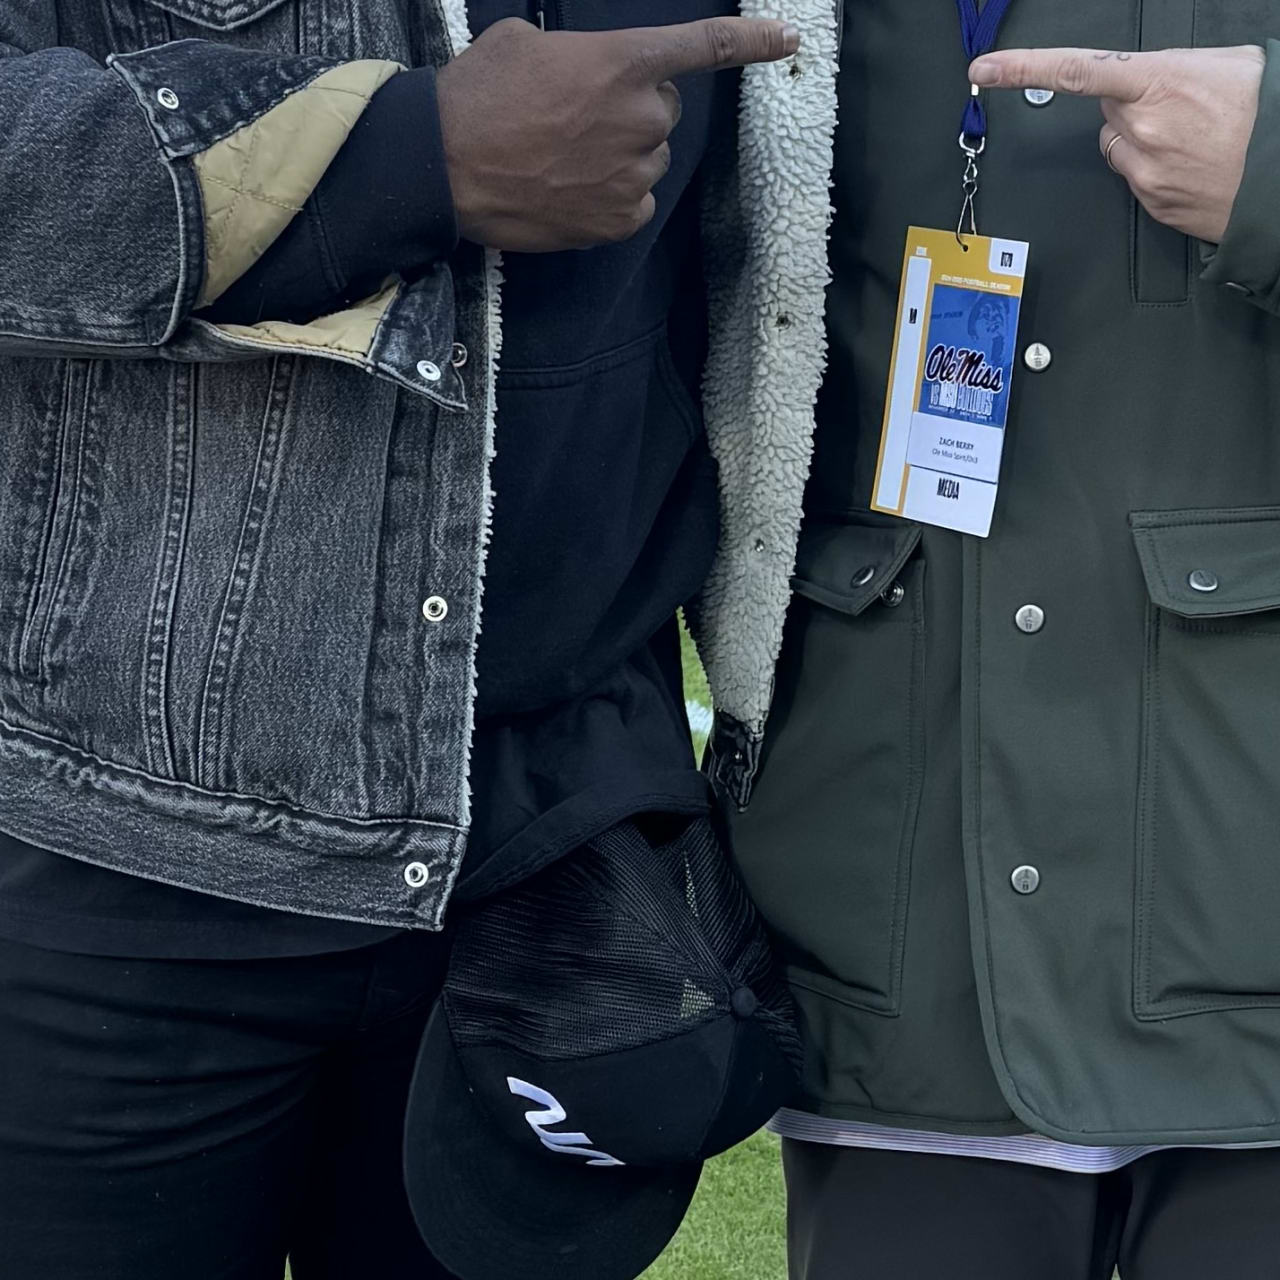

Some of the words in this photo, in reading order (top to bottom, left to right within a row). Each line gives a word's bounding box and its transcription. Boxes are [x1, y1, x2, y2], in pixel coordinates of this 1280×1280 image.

[925, 345, 958, 383] Ole
[956, 350, 1003, 392] Miss
[936, 477, 960, 501] MEDIA
